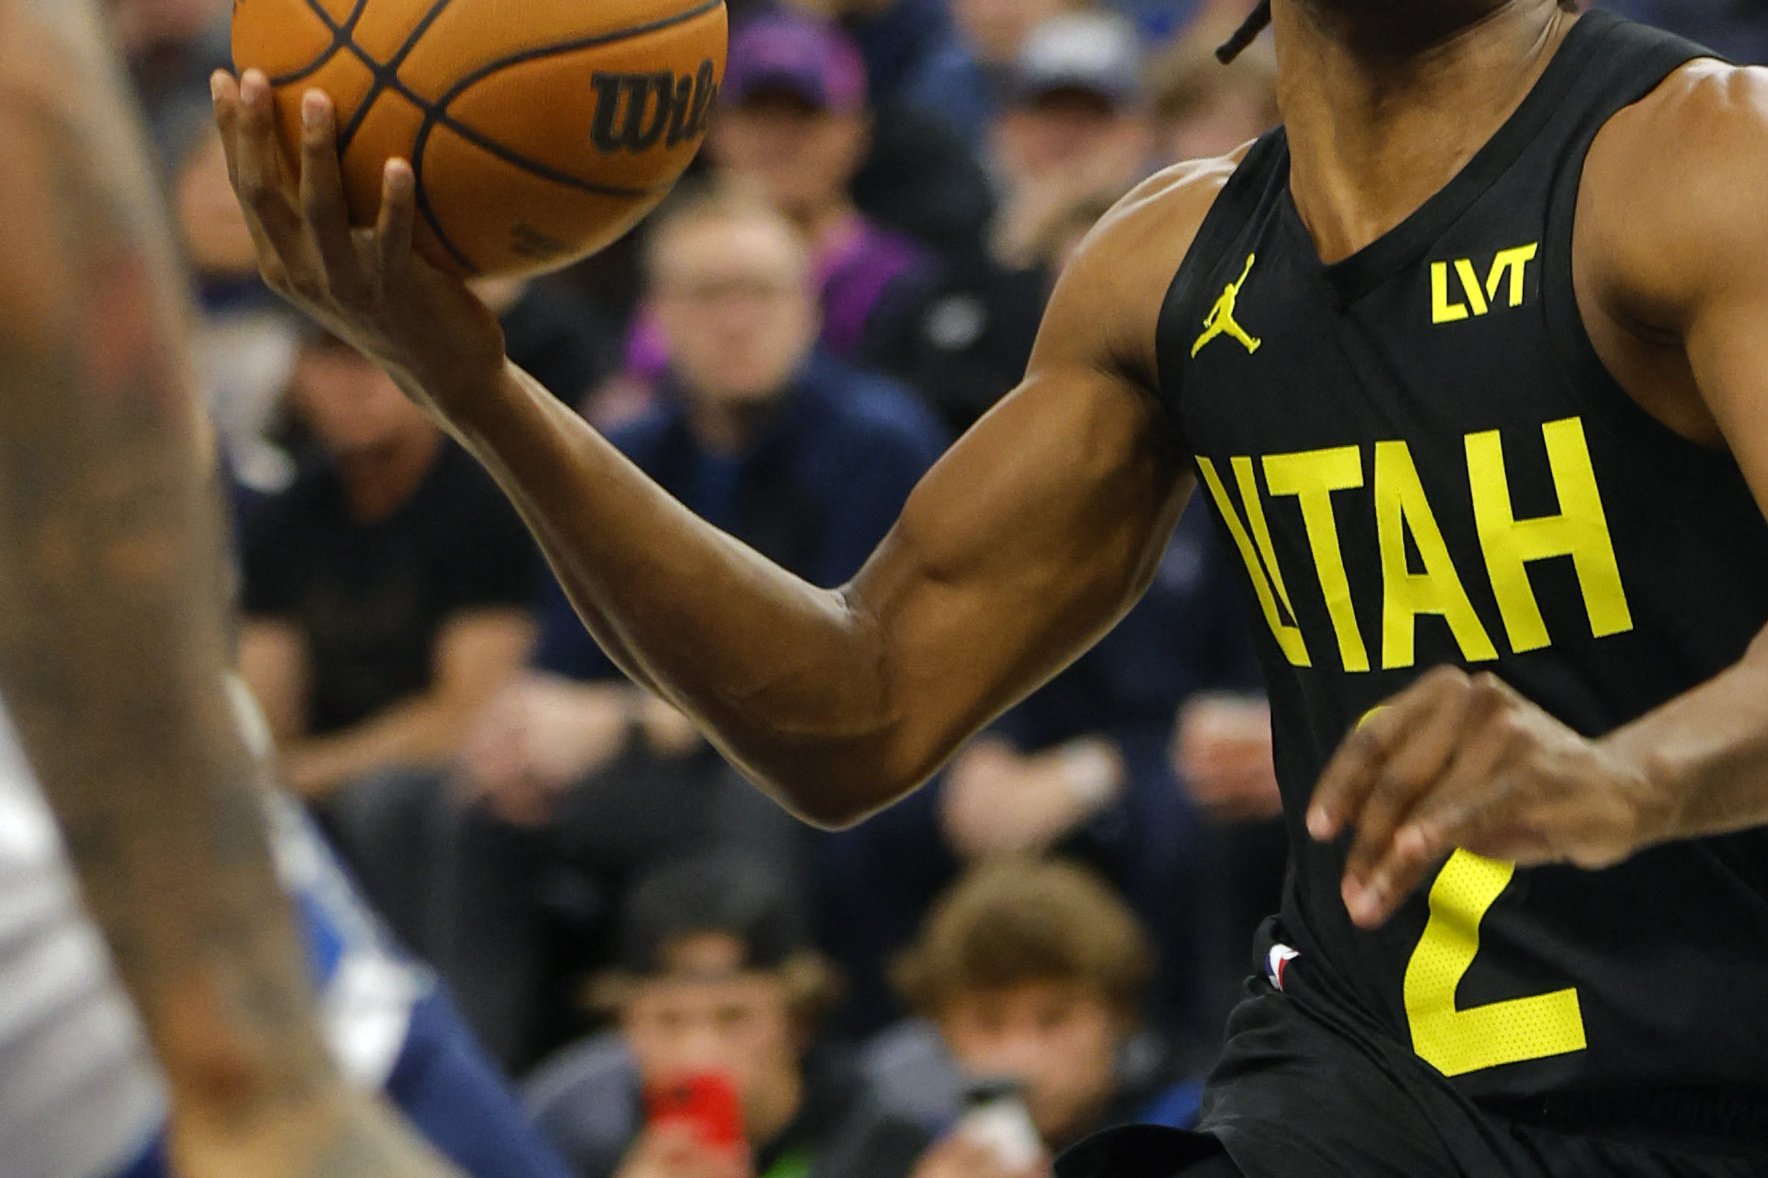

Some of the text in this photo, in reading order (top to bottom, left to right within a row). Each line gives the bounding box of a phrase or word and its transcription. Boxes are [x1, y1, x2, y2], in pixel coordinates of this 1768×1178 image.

[590, 57, 718, 154] Wil
[1430, 241, 1538, 325] LVT
[1195, 416, 1634, 673] UTAH
